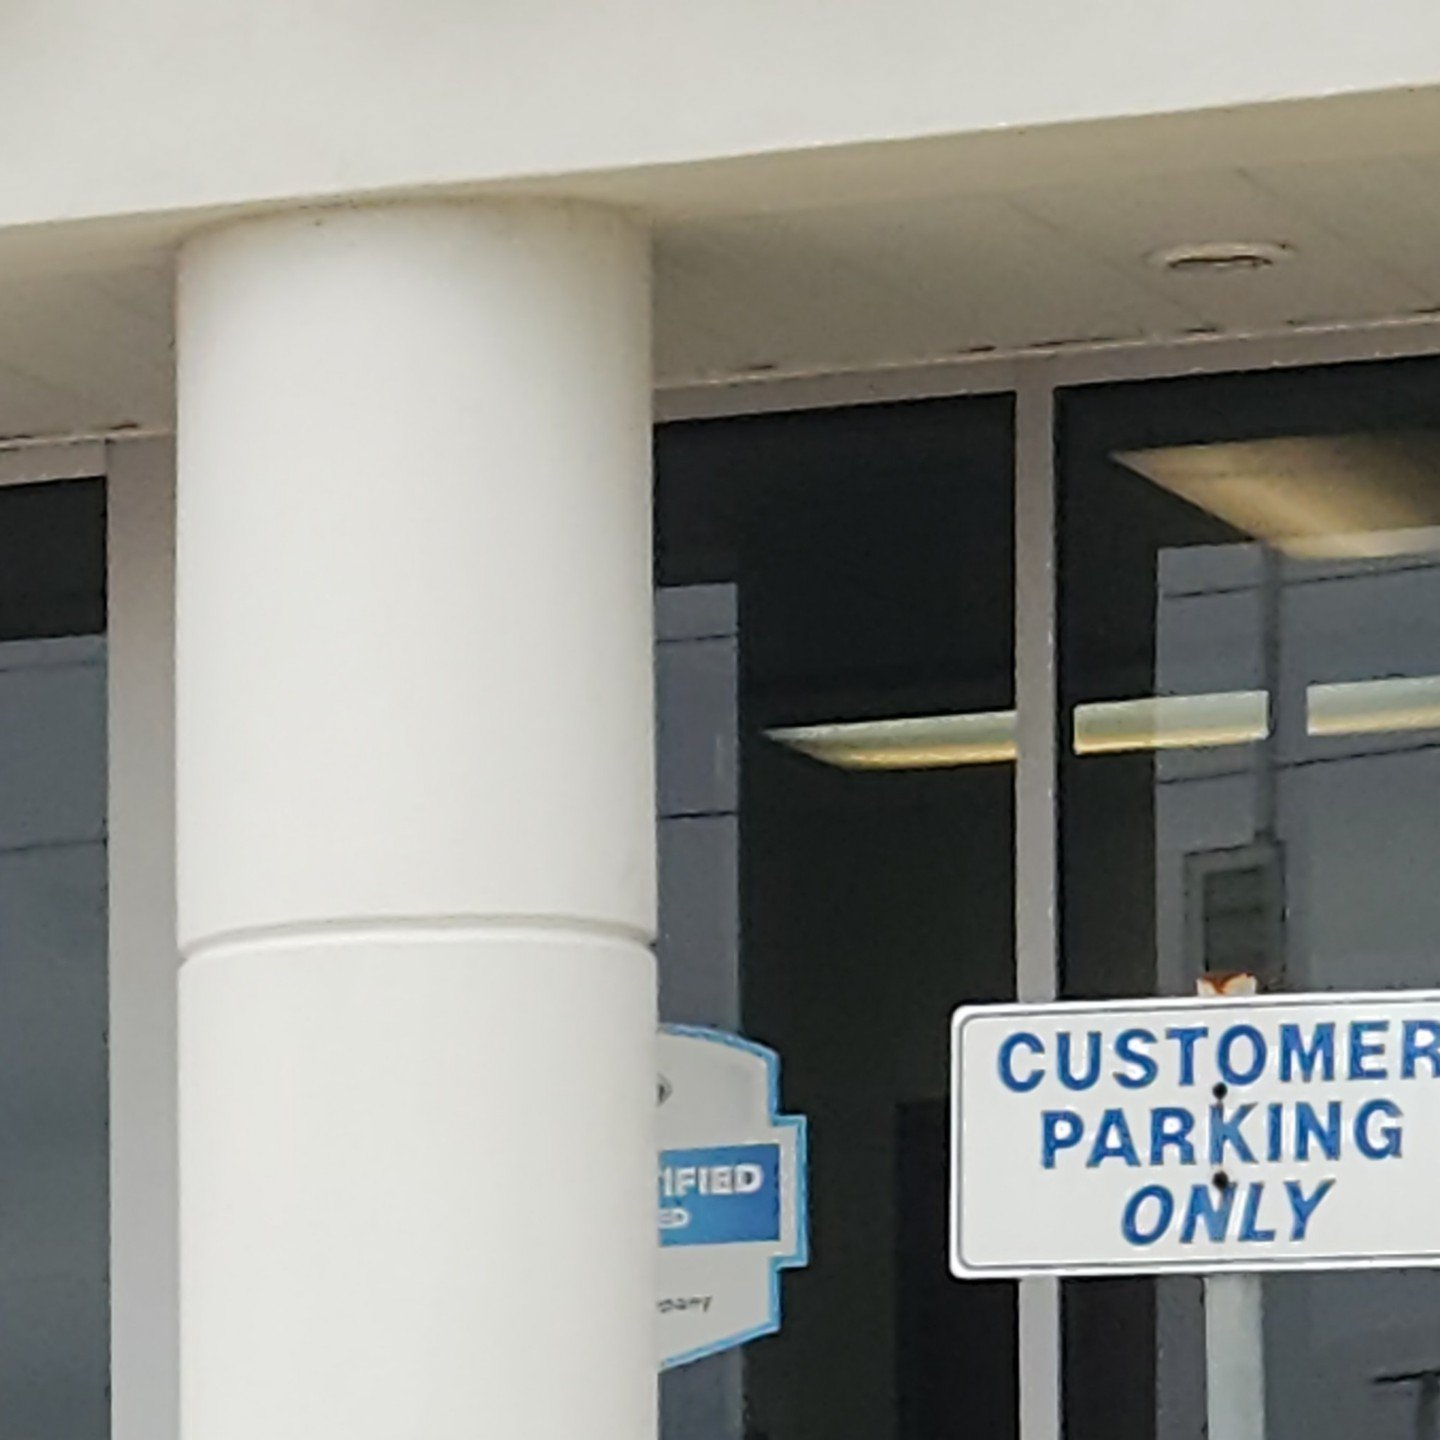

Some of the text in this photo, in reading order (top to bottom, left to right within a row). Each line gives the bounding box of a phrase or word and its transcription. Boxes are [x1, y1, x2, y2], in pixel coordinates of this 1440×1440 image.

[996, 1018, 1440, 1095] CUSTOMER
[1040, 1098, 1404, 1171] PARKING
[662, 1163, 764, 1198] IFIED
[1121, 1179, 1336, 1247] ONLY
